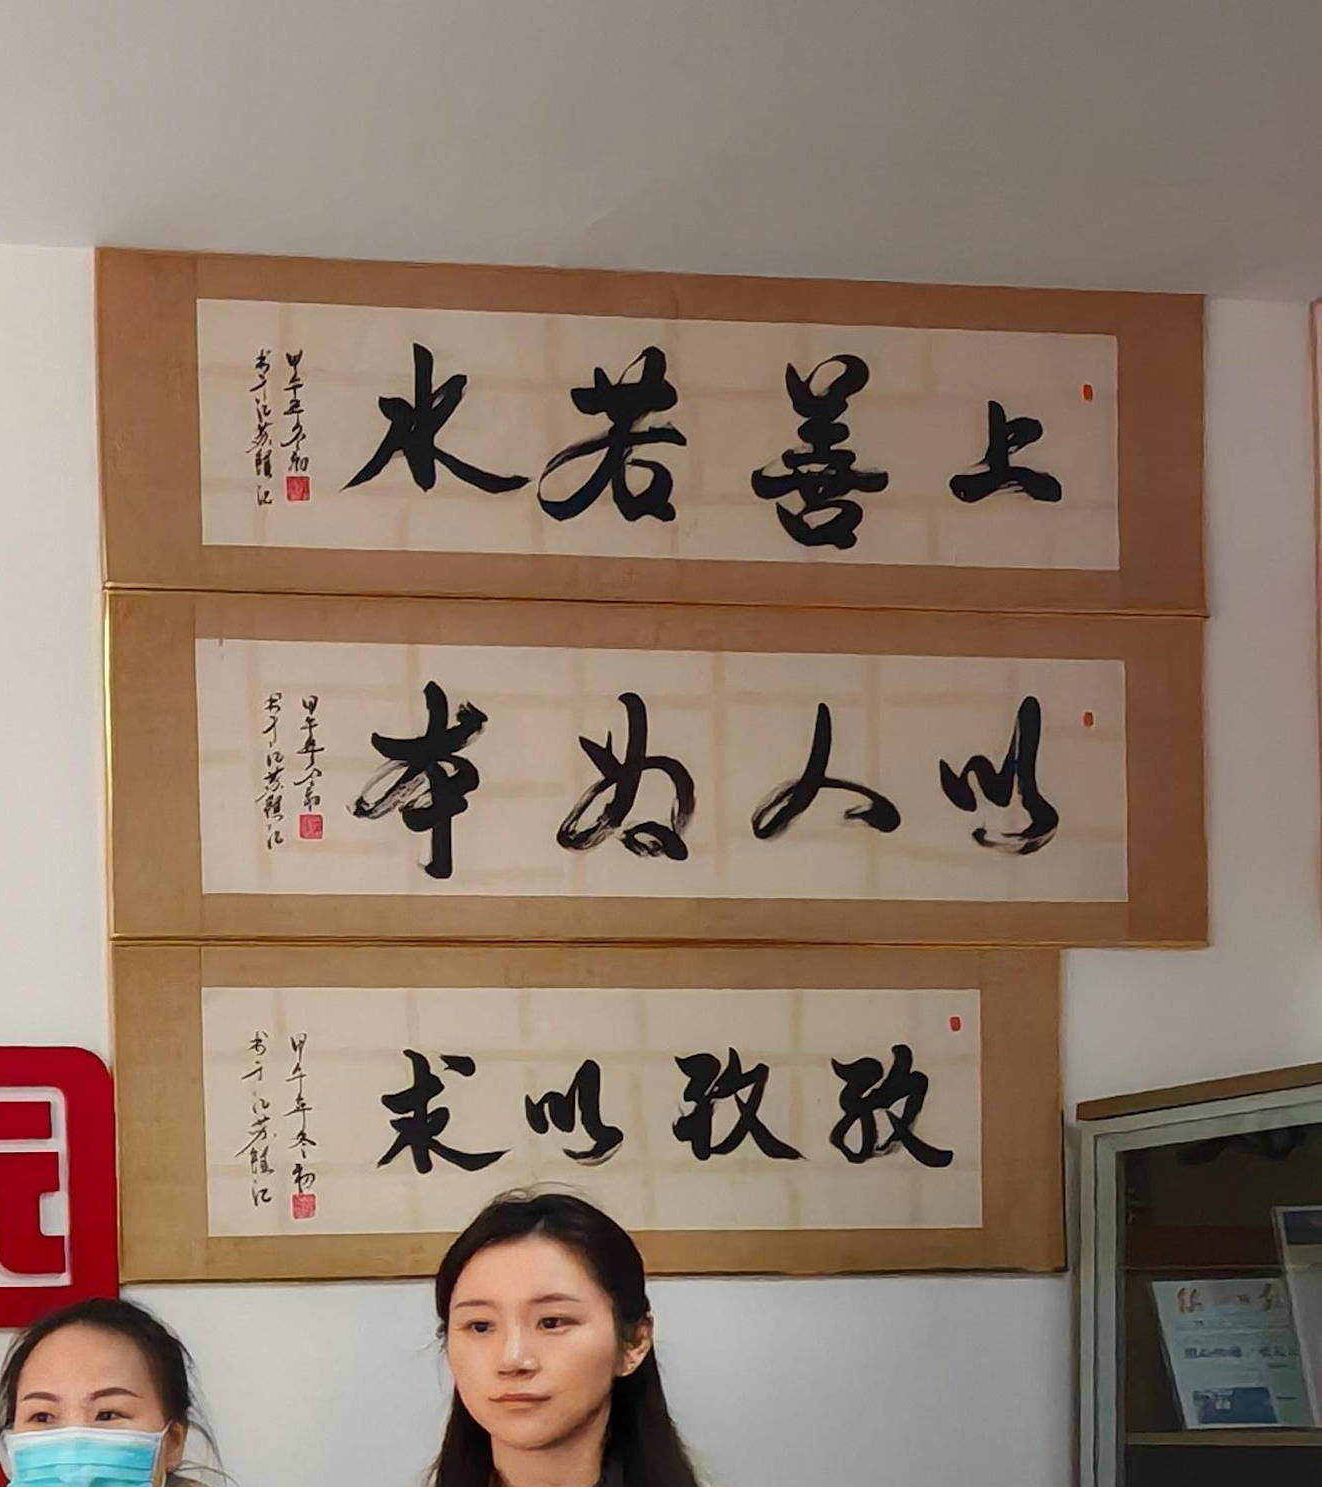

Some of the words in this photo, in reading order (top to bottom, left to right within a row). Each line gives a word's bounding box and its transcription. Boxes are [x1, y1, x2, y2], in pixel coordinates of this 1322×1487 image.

[340, 342, 1062, 550] 上善若水
[377, 1044, 954, 1174] 孜孜以求
